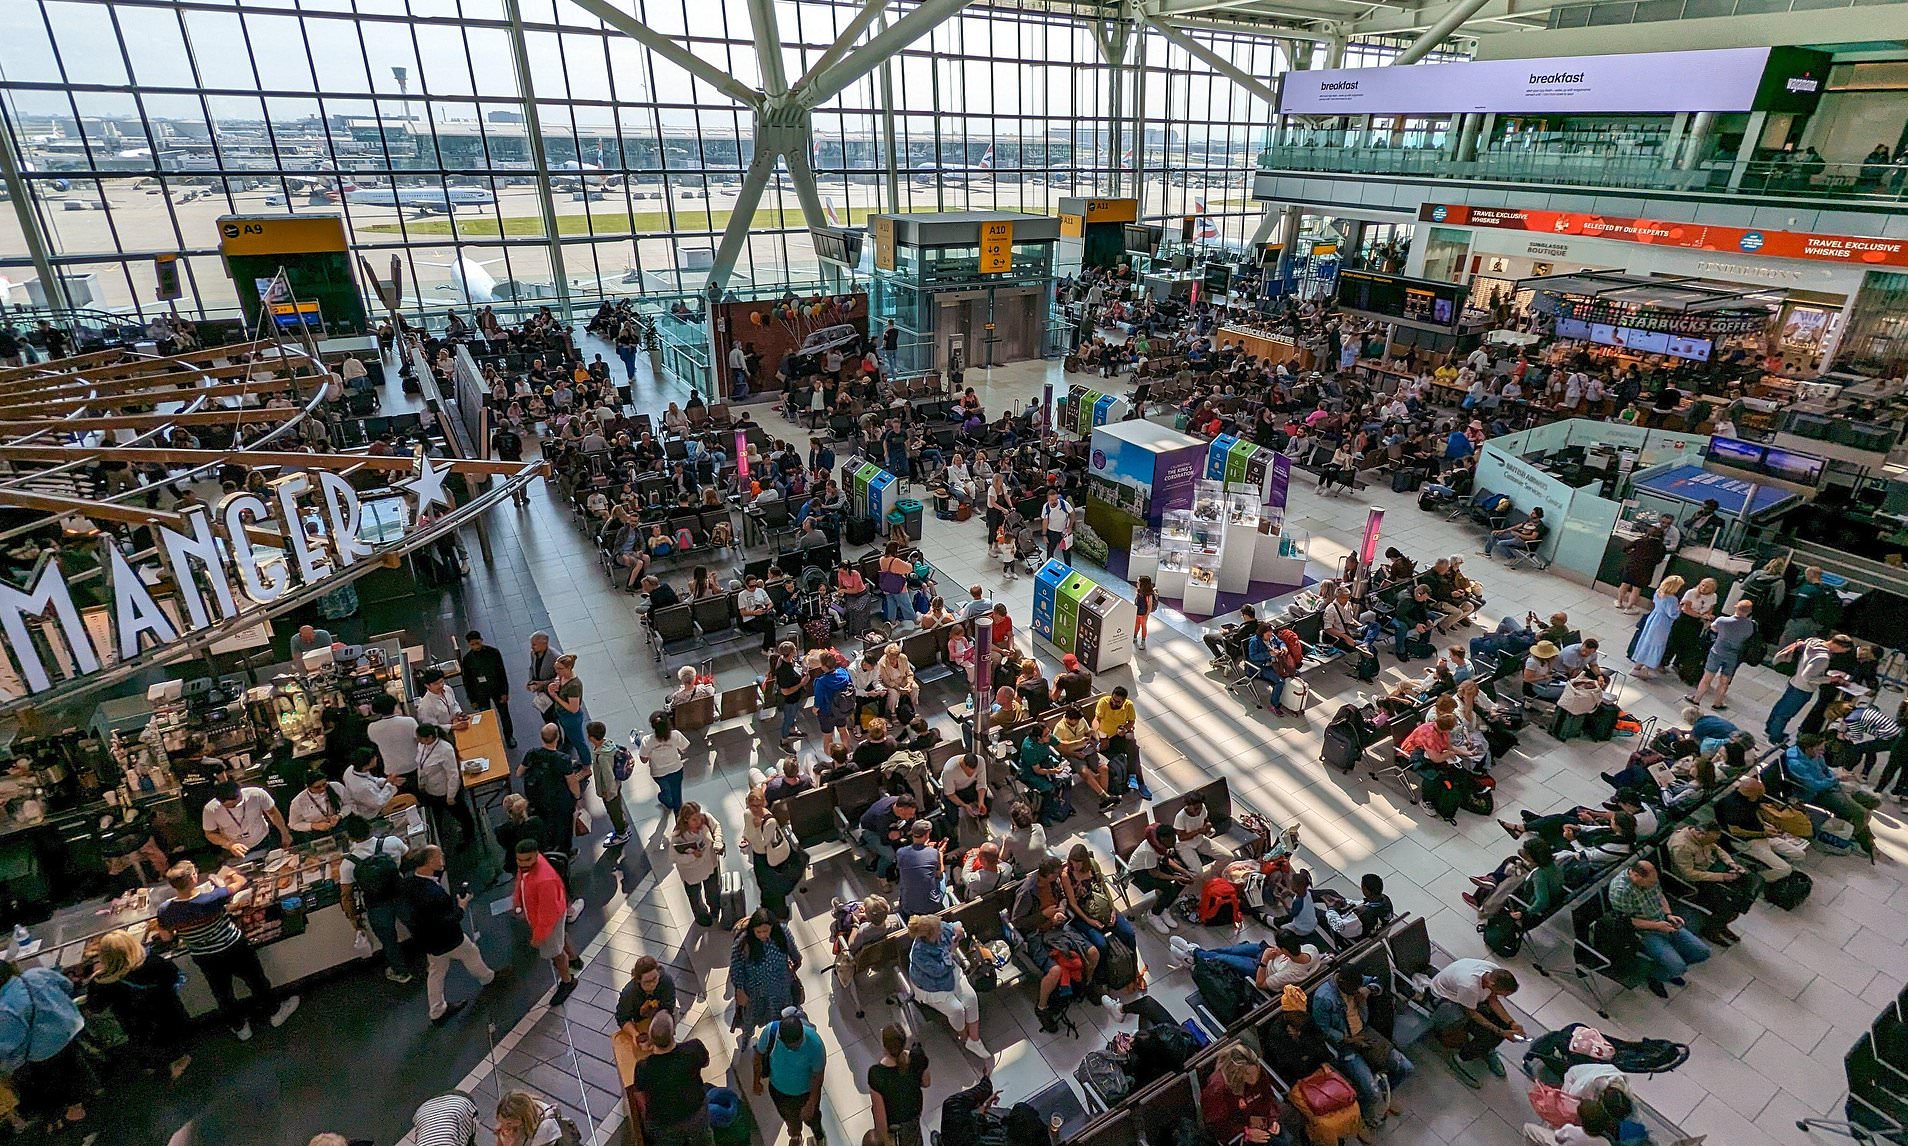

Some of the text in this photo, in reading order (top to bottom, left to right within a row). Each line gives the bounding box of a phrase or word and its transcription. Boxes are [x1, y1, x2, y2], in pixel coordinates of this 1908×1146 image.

[1529, 72, 1585, 84] breakfast
[1320, 80, 1359, 91] breakfast
[1096, 202, 1109, 210] A11
[1472, 216, 1500, 224] WHISKIES
[1473, 210, 1529, 220] TRAVEL EXCLUSIVE
[244, 224, 263, 235] A9
[989, 225, 1006, 235] A10
[1583, 222, 1614, 231] SELECTED
[1624, 226, 1637, 234] OUR
[1638, 228, 1669, 237] EXPERTS
[1808, 239, 1902, 252] TRAVEL EXCLUSIVE
[1527, 247, 1567, 257] BOUTIQUE
[1804, 247, 1851, 257] WHISKIES
[1620, 315, 1753, 332] STARBUCKS COFFEE
[1265, 332, 1295, 344] COFFEE
[0, 471, 373, 693] MANGER
